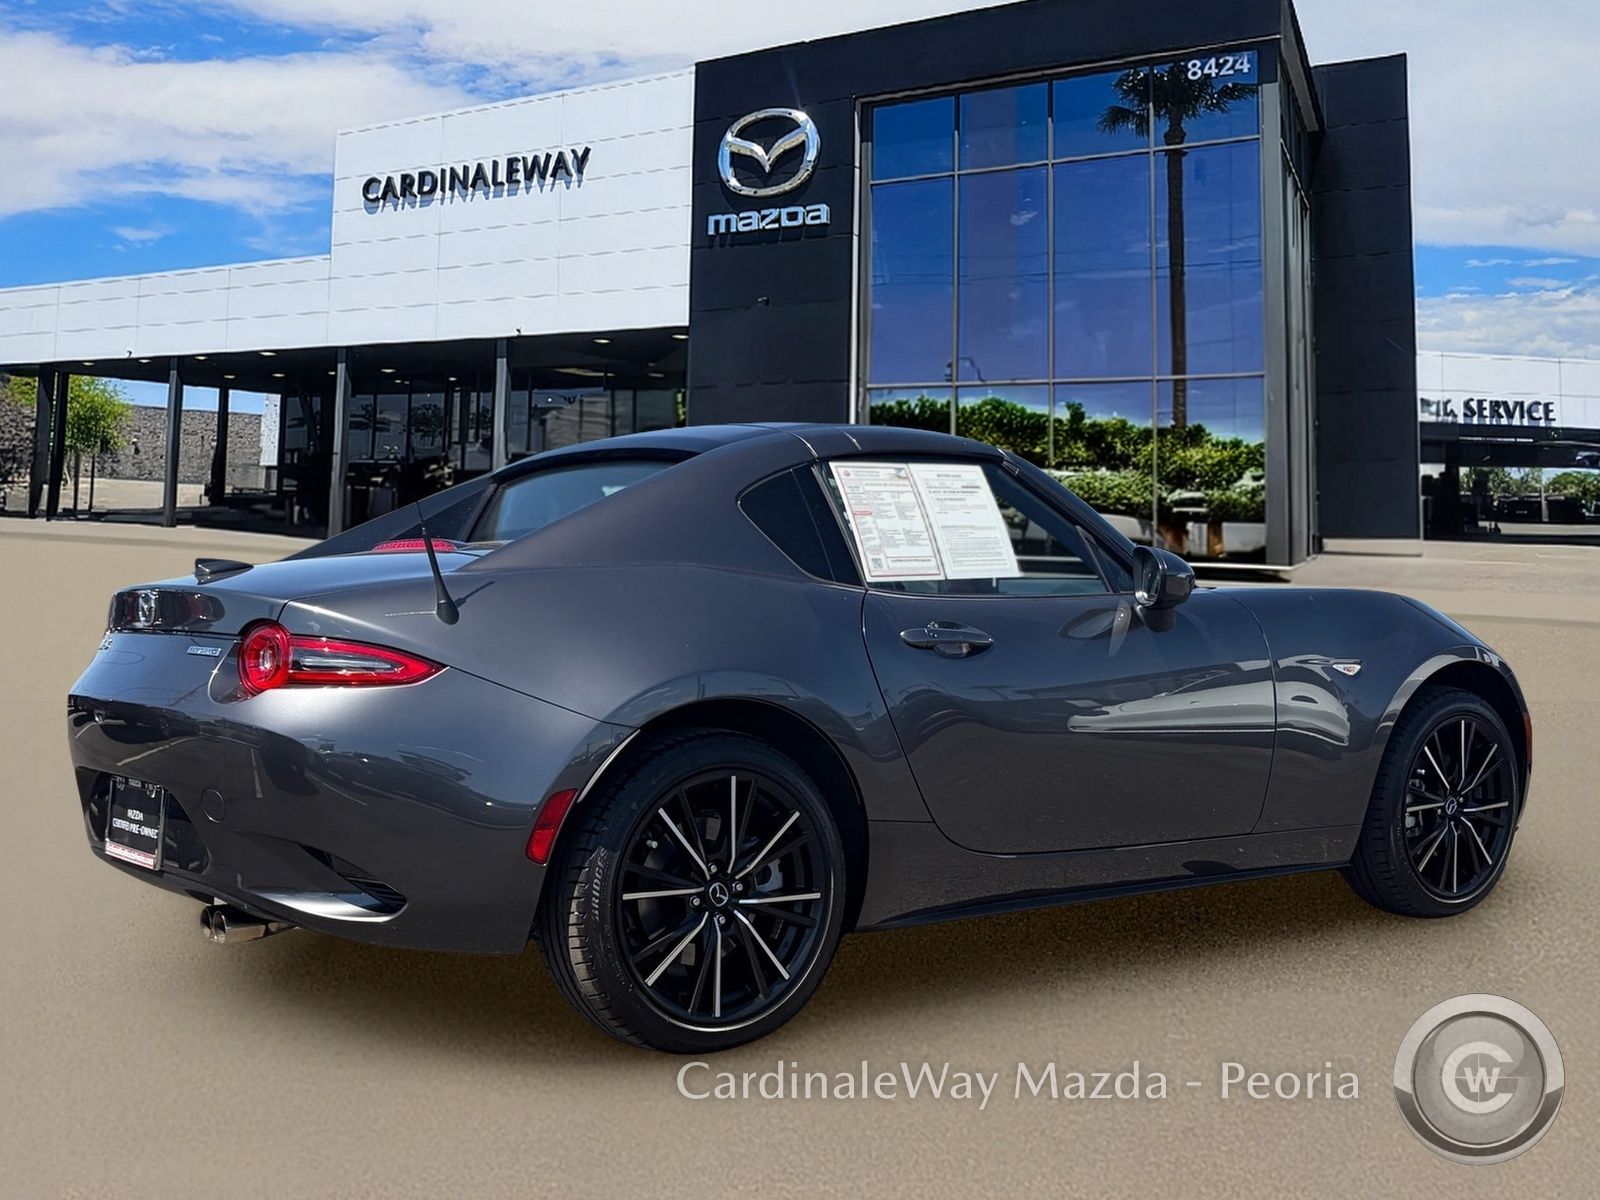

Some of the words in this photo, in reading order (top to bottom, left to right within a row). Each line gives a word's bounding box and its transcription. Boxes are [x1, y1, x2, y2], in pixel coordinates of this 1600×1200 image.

[1187, 54, 1251, 81] 8424
[362, 146, 592, 203] CARDINALEWAY
[1462, 397, 1556, 422] SERVICE
